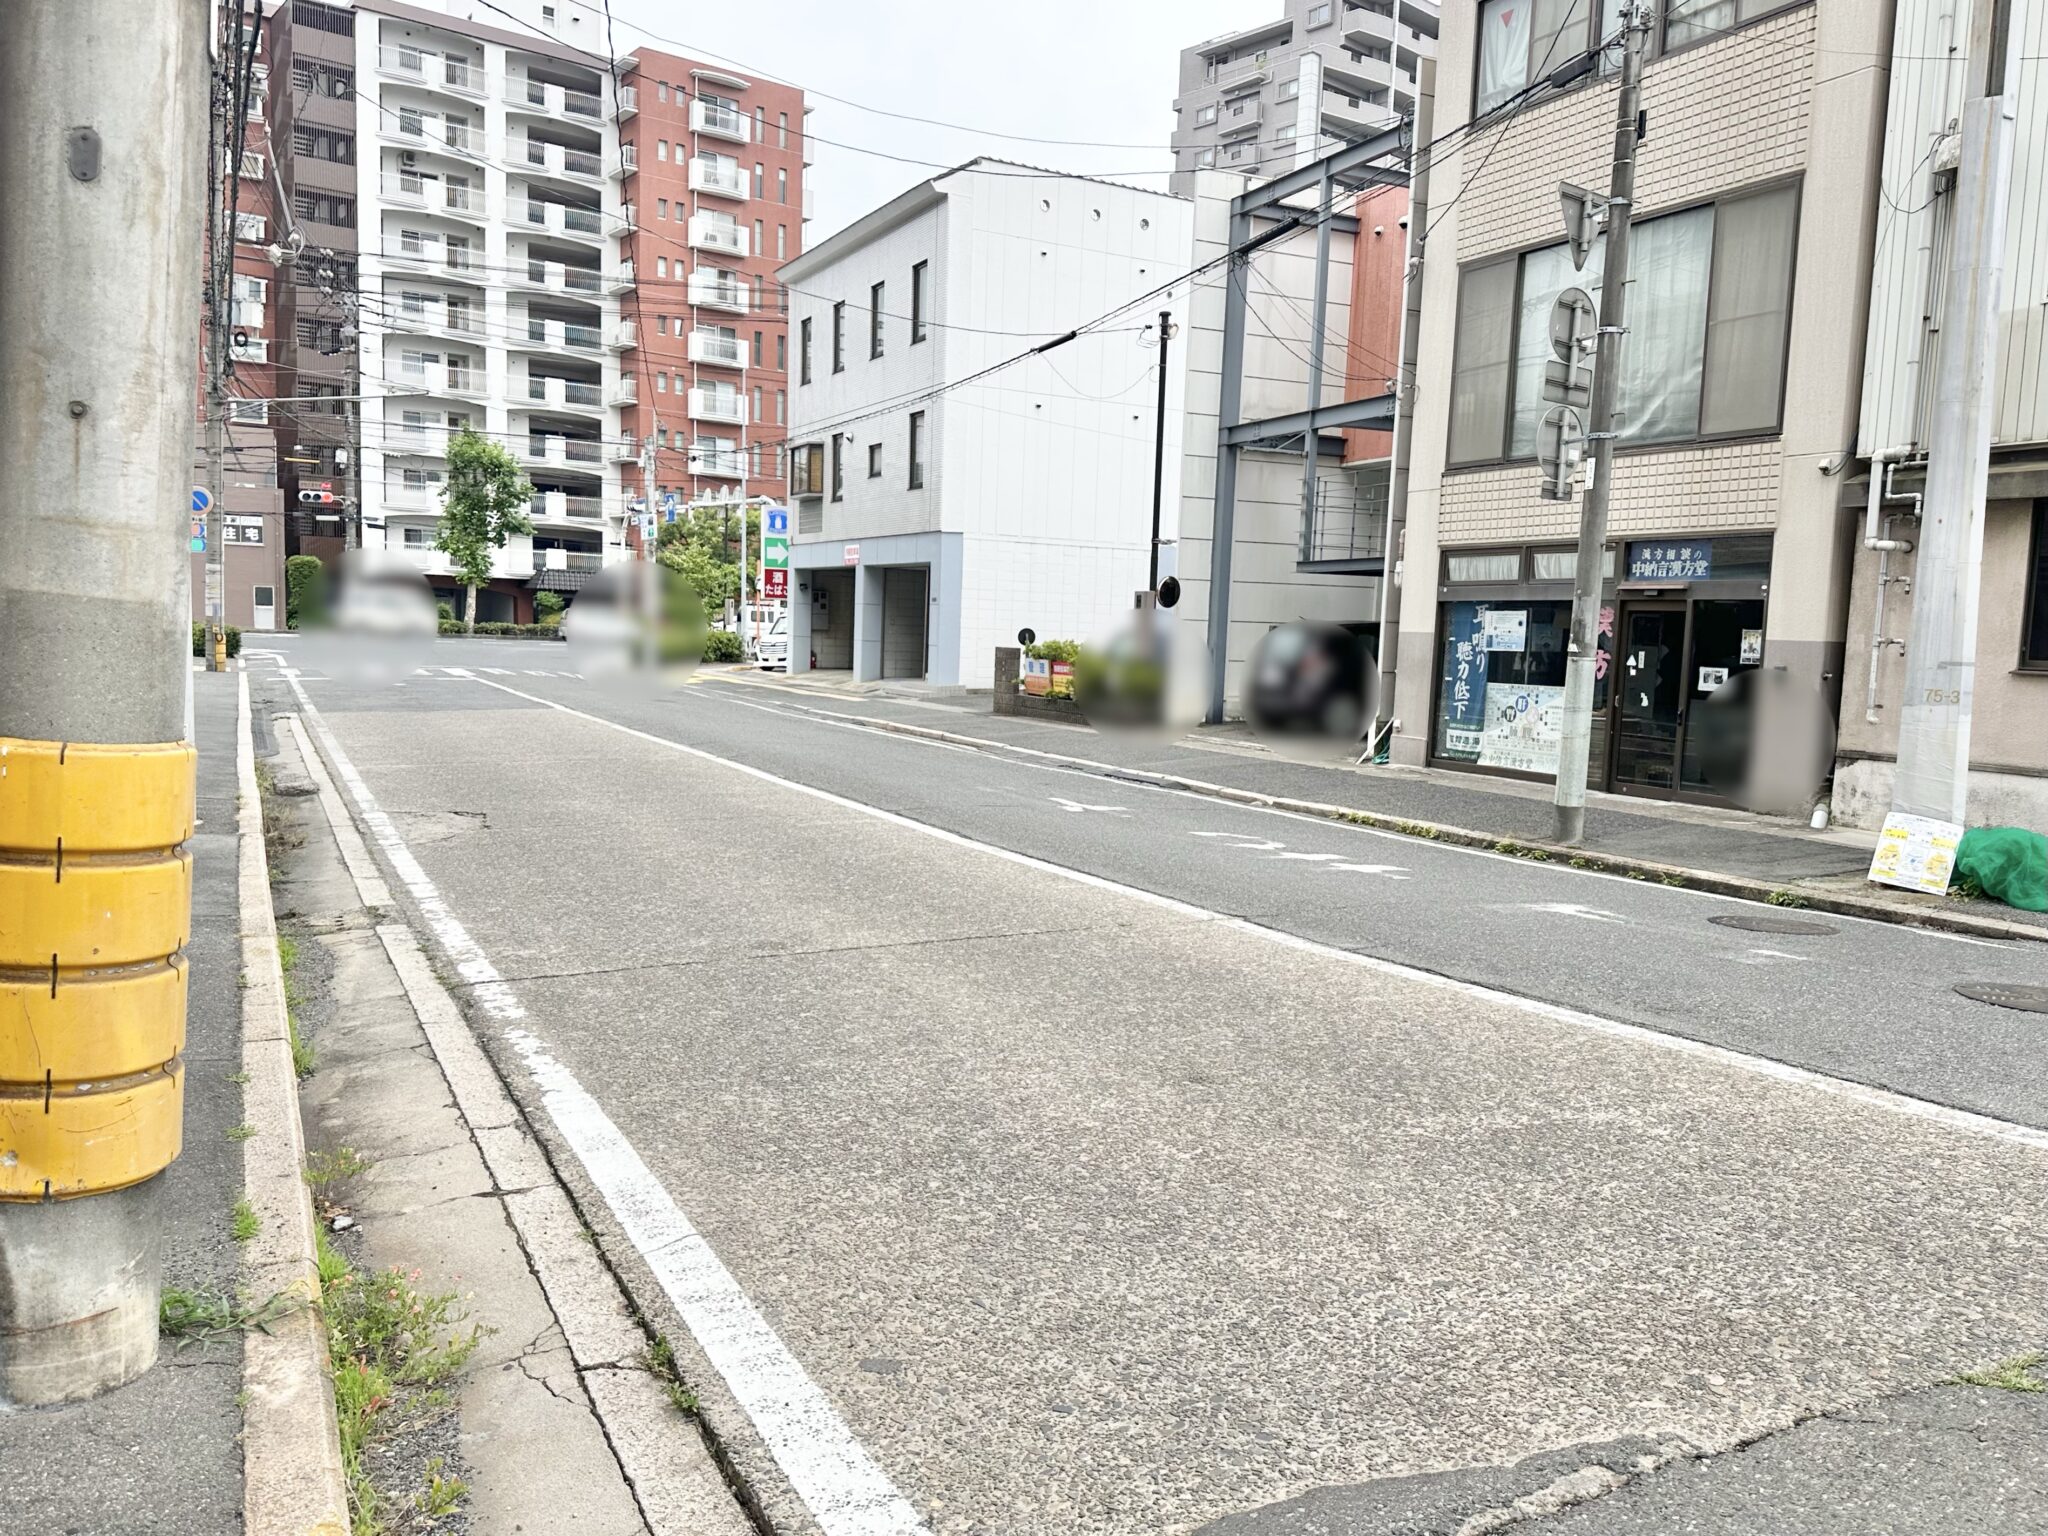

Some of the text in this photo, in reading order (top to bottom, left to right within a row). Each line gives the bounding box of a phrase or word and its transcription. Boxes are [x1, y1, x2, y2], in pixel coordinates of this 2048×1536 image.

[1641, 547, 1702, 560] 漢方相談の
[1632, 559, 1709, 577] 中納言漢方堂
[772, 571, 784, 584] 酒
[1924, 688, 1961, 704] 75-3
